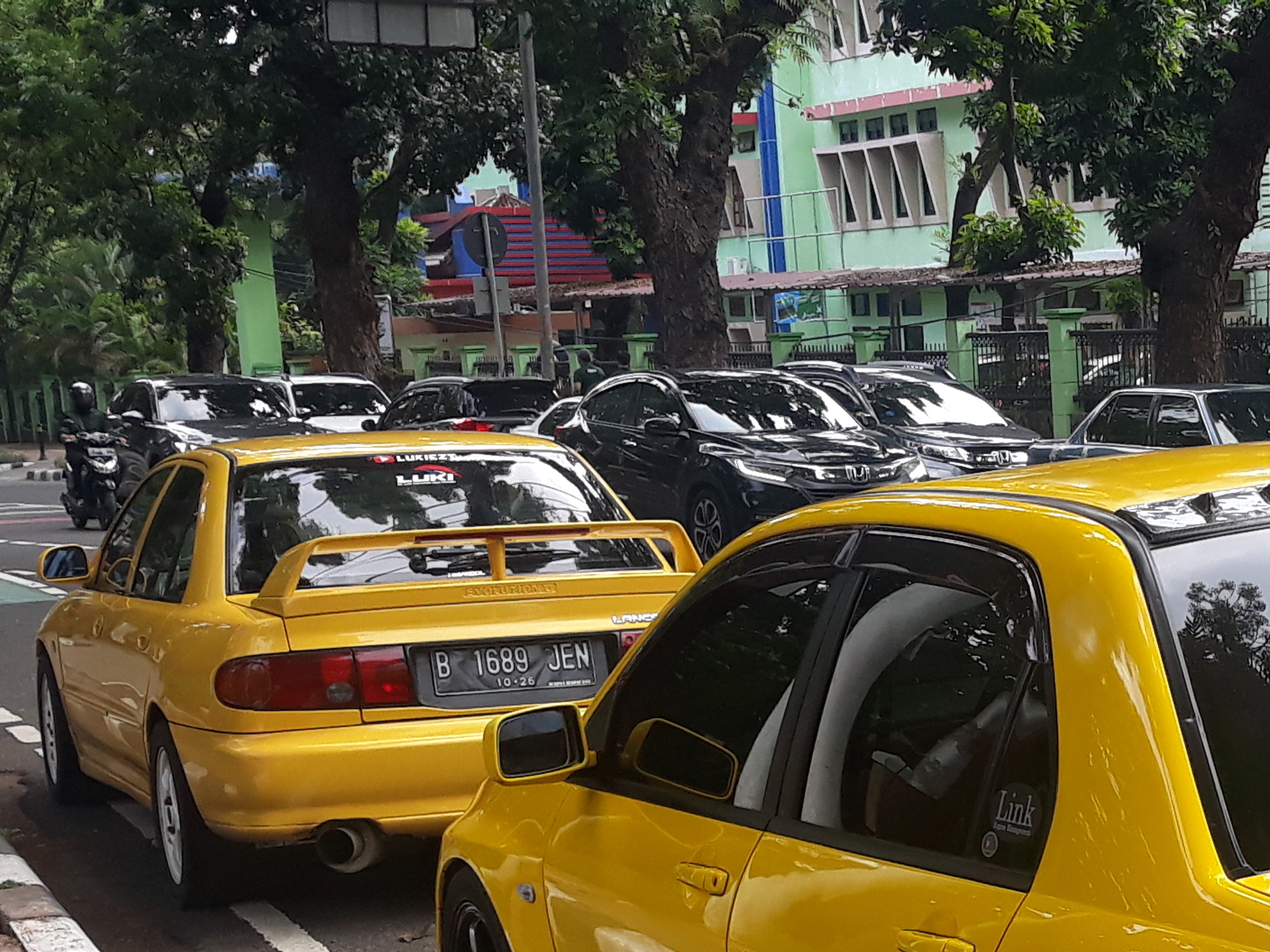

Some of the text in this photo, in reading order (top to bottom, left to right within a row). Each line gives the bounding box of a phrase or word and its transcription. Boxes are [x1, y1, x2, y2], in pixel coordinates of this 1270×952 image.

[396, 473, 454, 483] LUKI
[435, 643, 591, 679] B 1689 JEN
[995, 789, 1037, 828] Link
